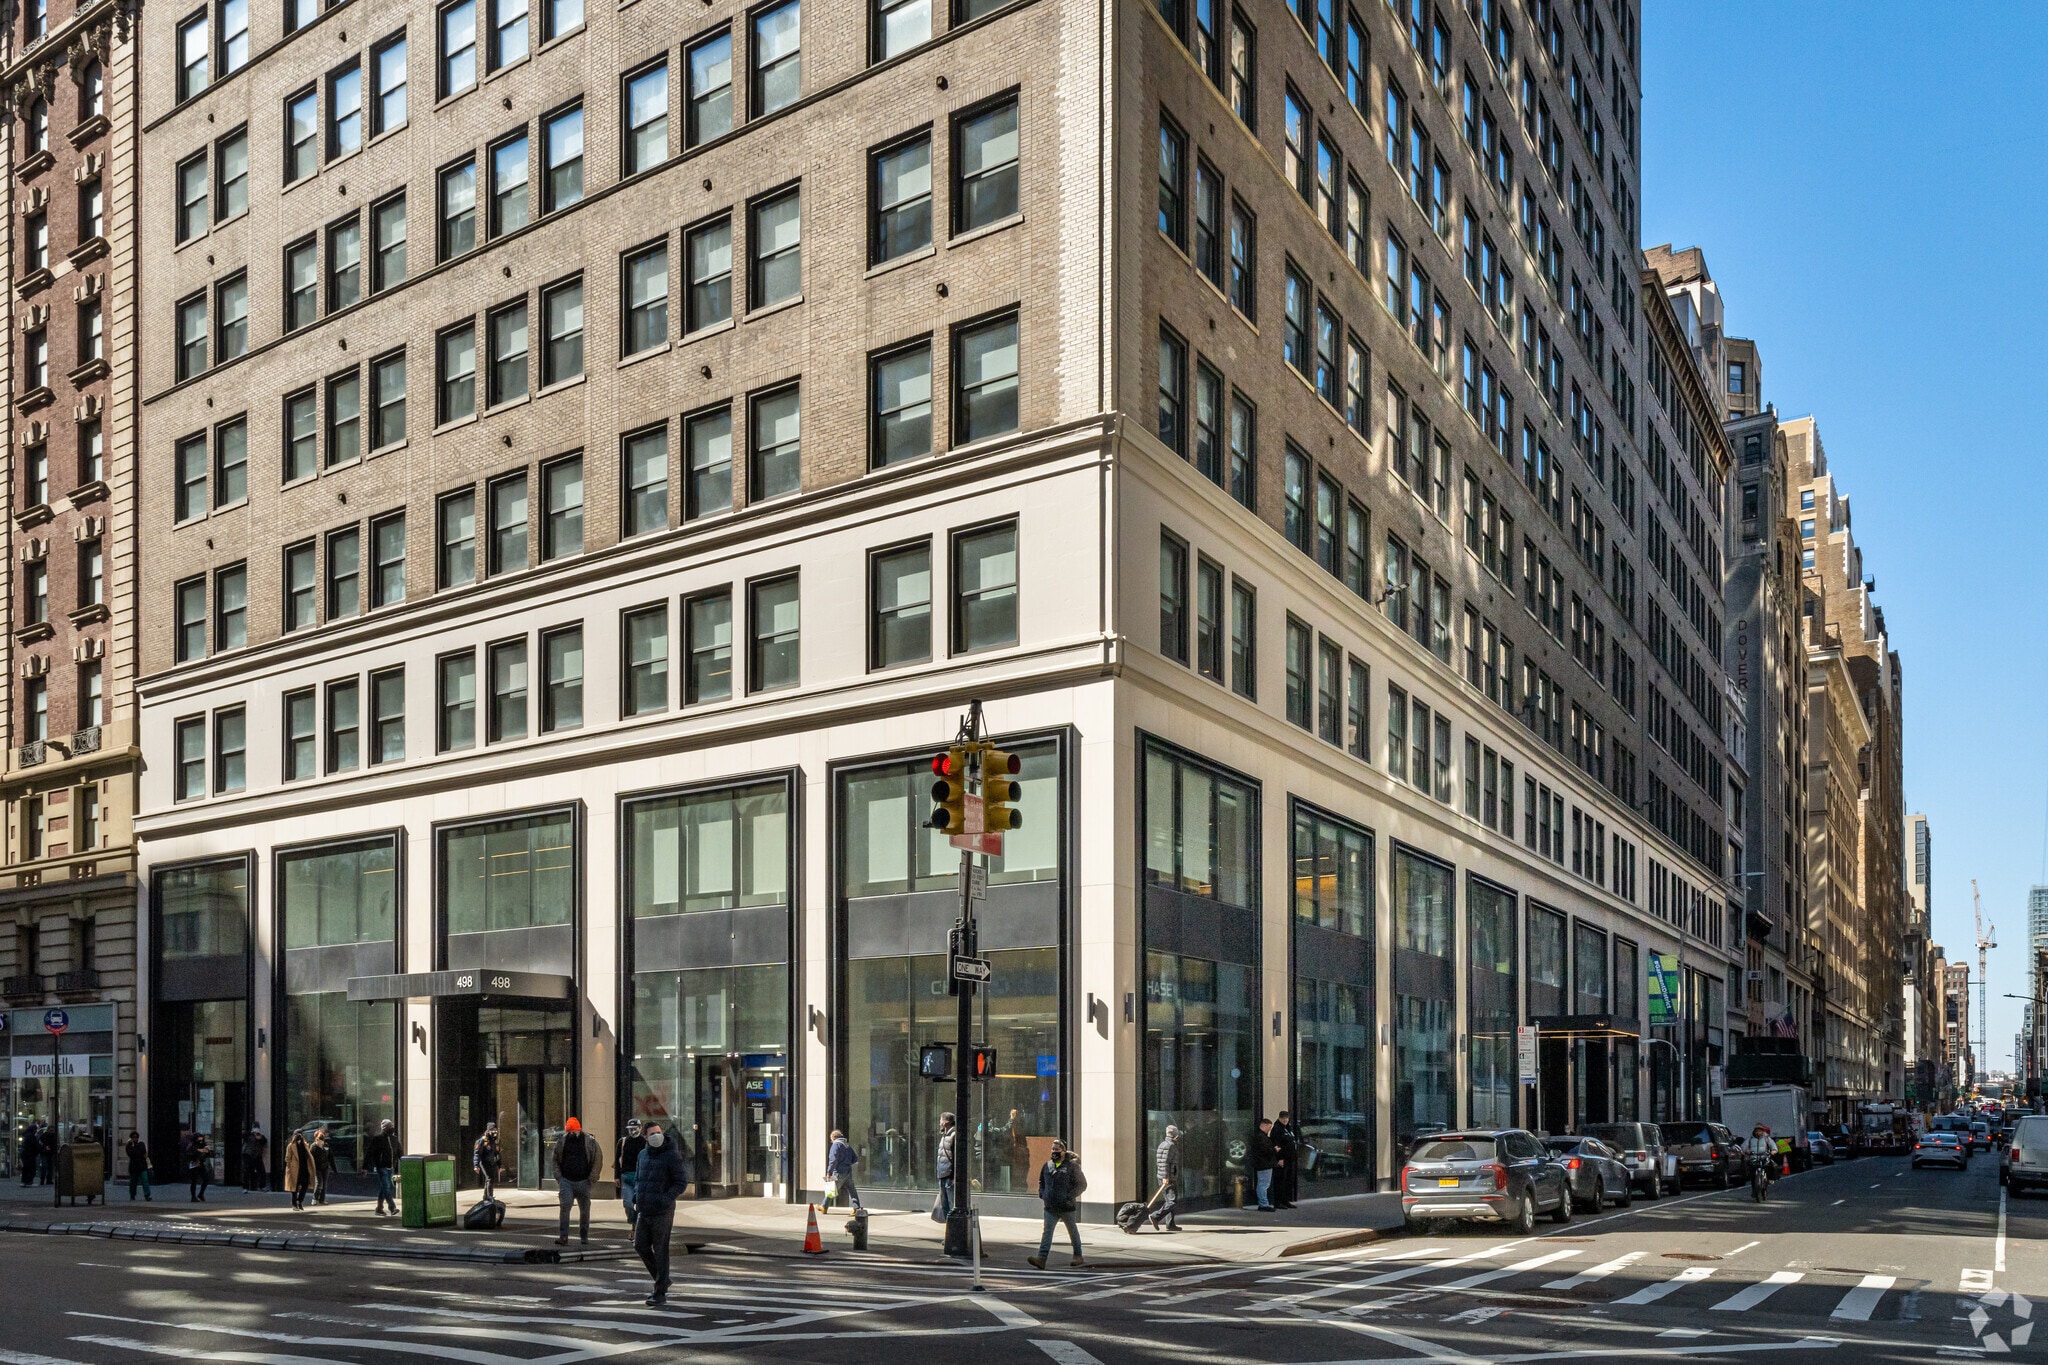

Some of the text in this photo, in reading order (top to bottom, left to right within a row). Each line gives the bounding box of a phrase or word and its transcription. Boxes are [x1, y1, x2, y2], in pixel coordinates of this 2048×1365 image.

[1738, 620, 1748, 689] DOVER
[957, 962, 986, 975] ONE WAY
[456, 976, 473, 988] 498
[491, 976, 511, 989] 498
[1146, 980, 1172, 997] HASE
[746, 1081, 763, 1090] ASE
